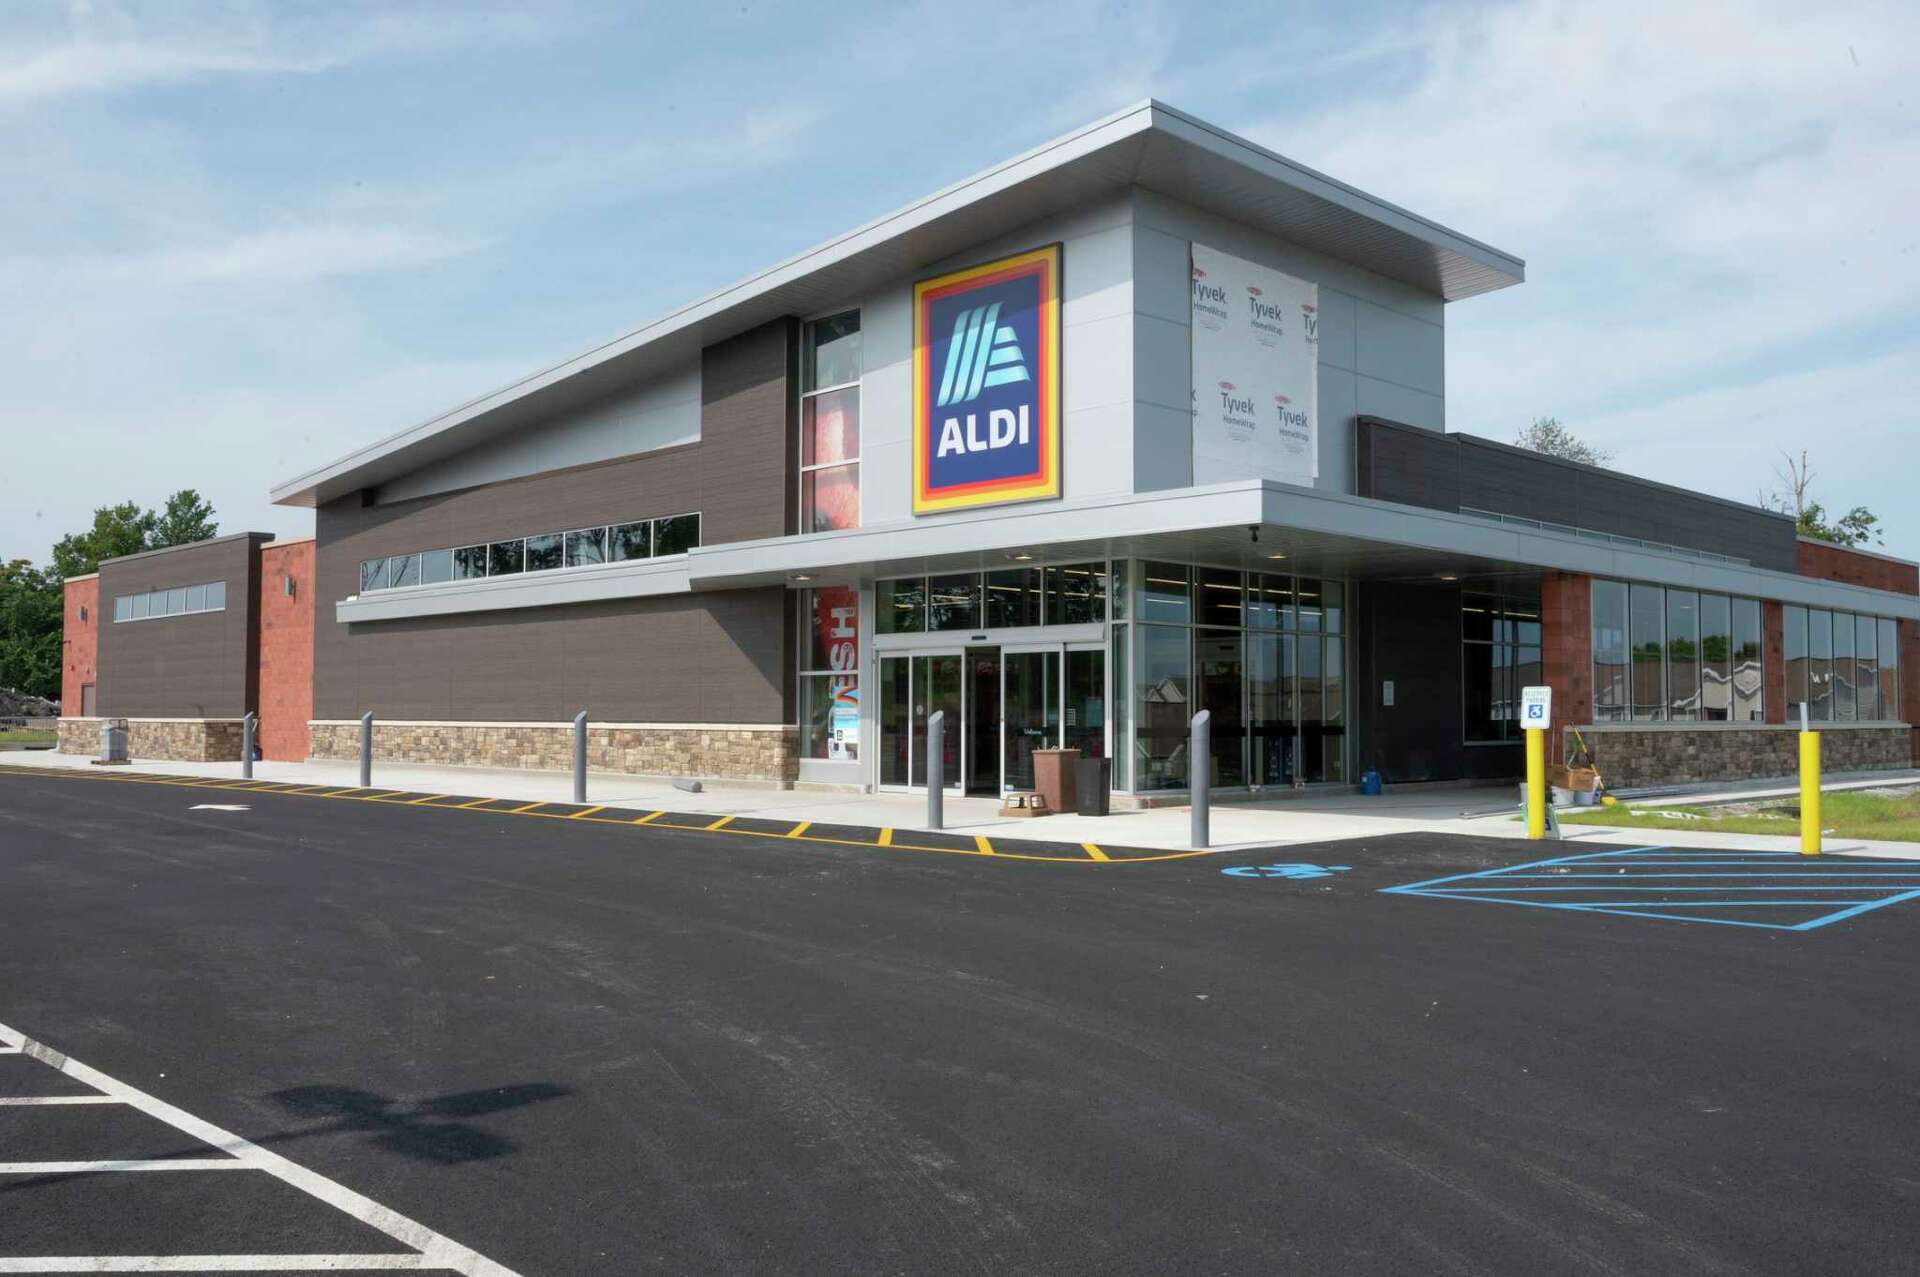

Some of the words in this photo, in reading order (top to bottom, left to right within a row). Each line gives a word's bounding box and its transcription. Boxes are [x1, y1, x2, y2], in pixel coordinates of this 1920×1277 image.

[1191, 279, 1226, 304] Tyvek
[1249, 297, 1281, 321] Tyvek
[1221, 392, 1255, 415] Tyvek
[1277, 406, 1308, 427] Tyvek
[937, 405, 1029, 458] ALDI
